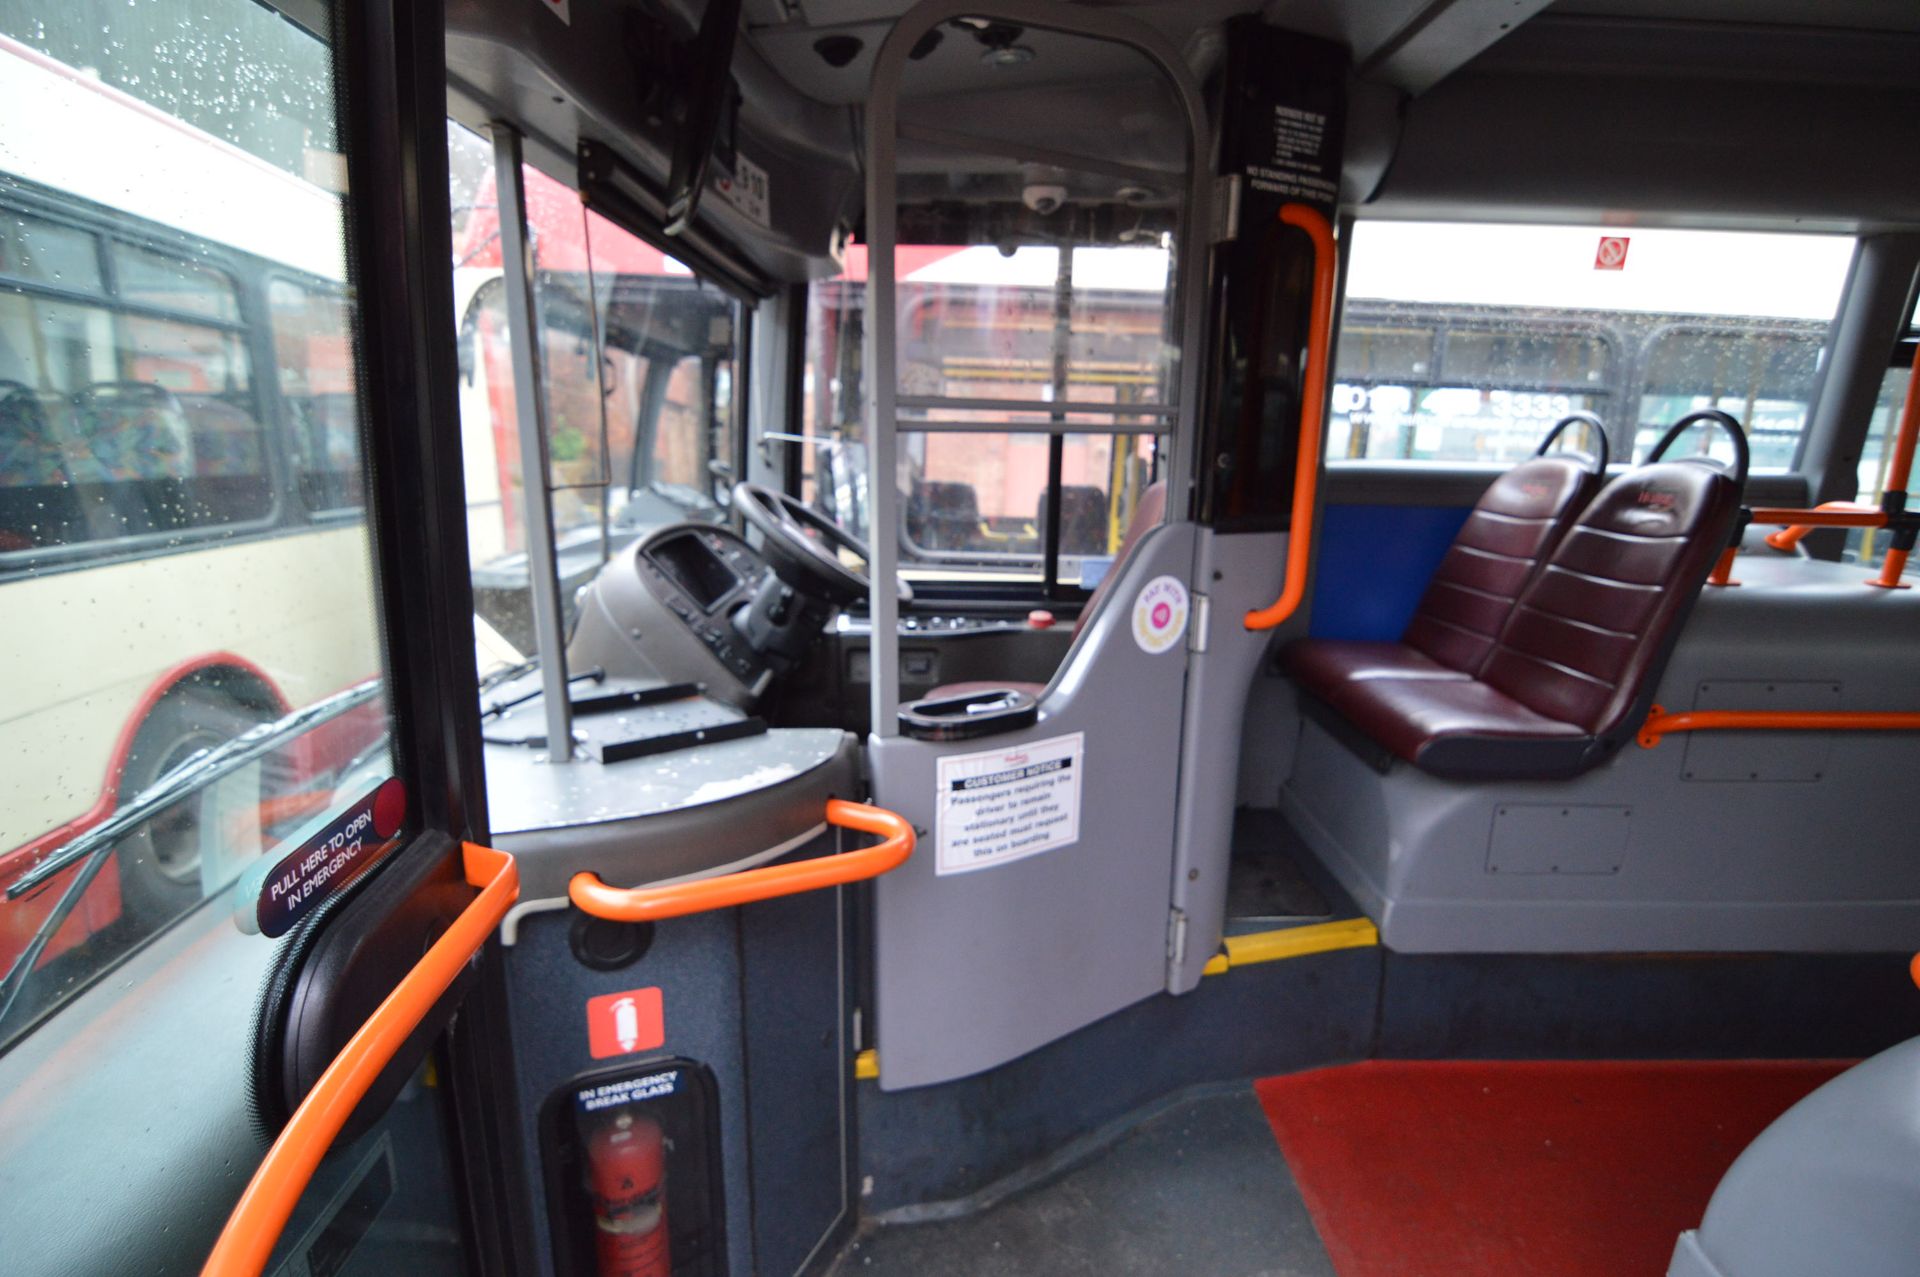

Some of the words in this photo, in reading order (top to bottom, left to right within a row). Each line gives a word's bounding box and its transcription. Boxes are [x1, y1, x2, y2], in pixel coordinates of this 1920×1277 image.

[964, 768, 1025, 788] CUSTOMER
[1026, 760, 1062, 777] NOTICE
[951, 789, 1011, 806] Passengers
[1014, 778, 1054, 793] requiring
[1057, 774, 1072, 785] the
[975, 803, 1005, 816] driver
[1008, 801, 1017, 809] to
[1020, 793, 1051, 806] remain
[951, 838, 969, 847] are
[973, 830, 1007, 844] seated
[1010, 823, 1033, 834] must
[1035, 813, 1068, 828] request
[964, 815, 1014, 832] stationary
[1018, 809, 1038, 820] until
[1040, 804, 1059, 815] they
[271, 870, 300, 902] PULL
[300, 844, 328, 878] HERE
[328, 832, 344, 853] TO
[345, 809, 372, 839] OPEN
[974, 846, 993, 857] this
[996, 844, 1008, 852] on
[1010, 832, 1050, 848] boarding
[287, 889, 302, 911] IN
[302, 836, 362, 899] EMERGENCY
[579, 1088, 596, 1101] IN
[597, 1070, 678, 1098] EMERGENCY
[585, 1092, 630, 1112] BREAK
[631, 1082, 674, 1101] GLASS
